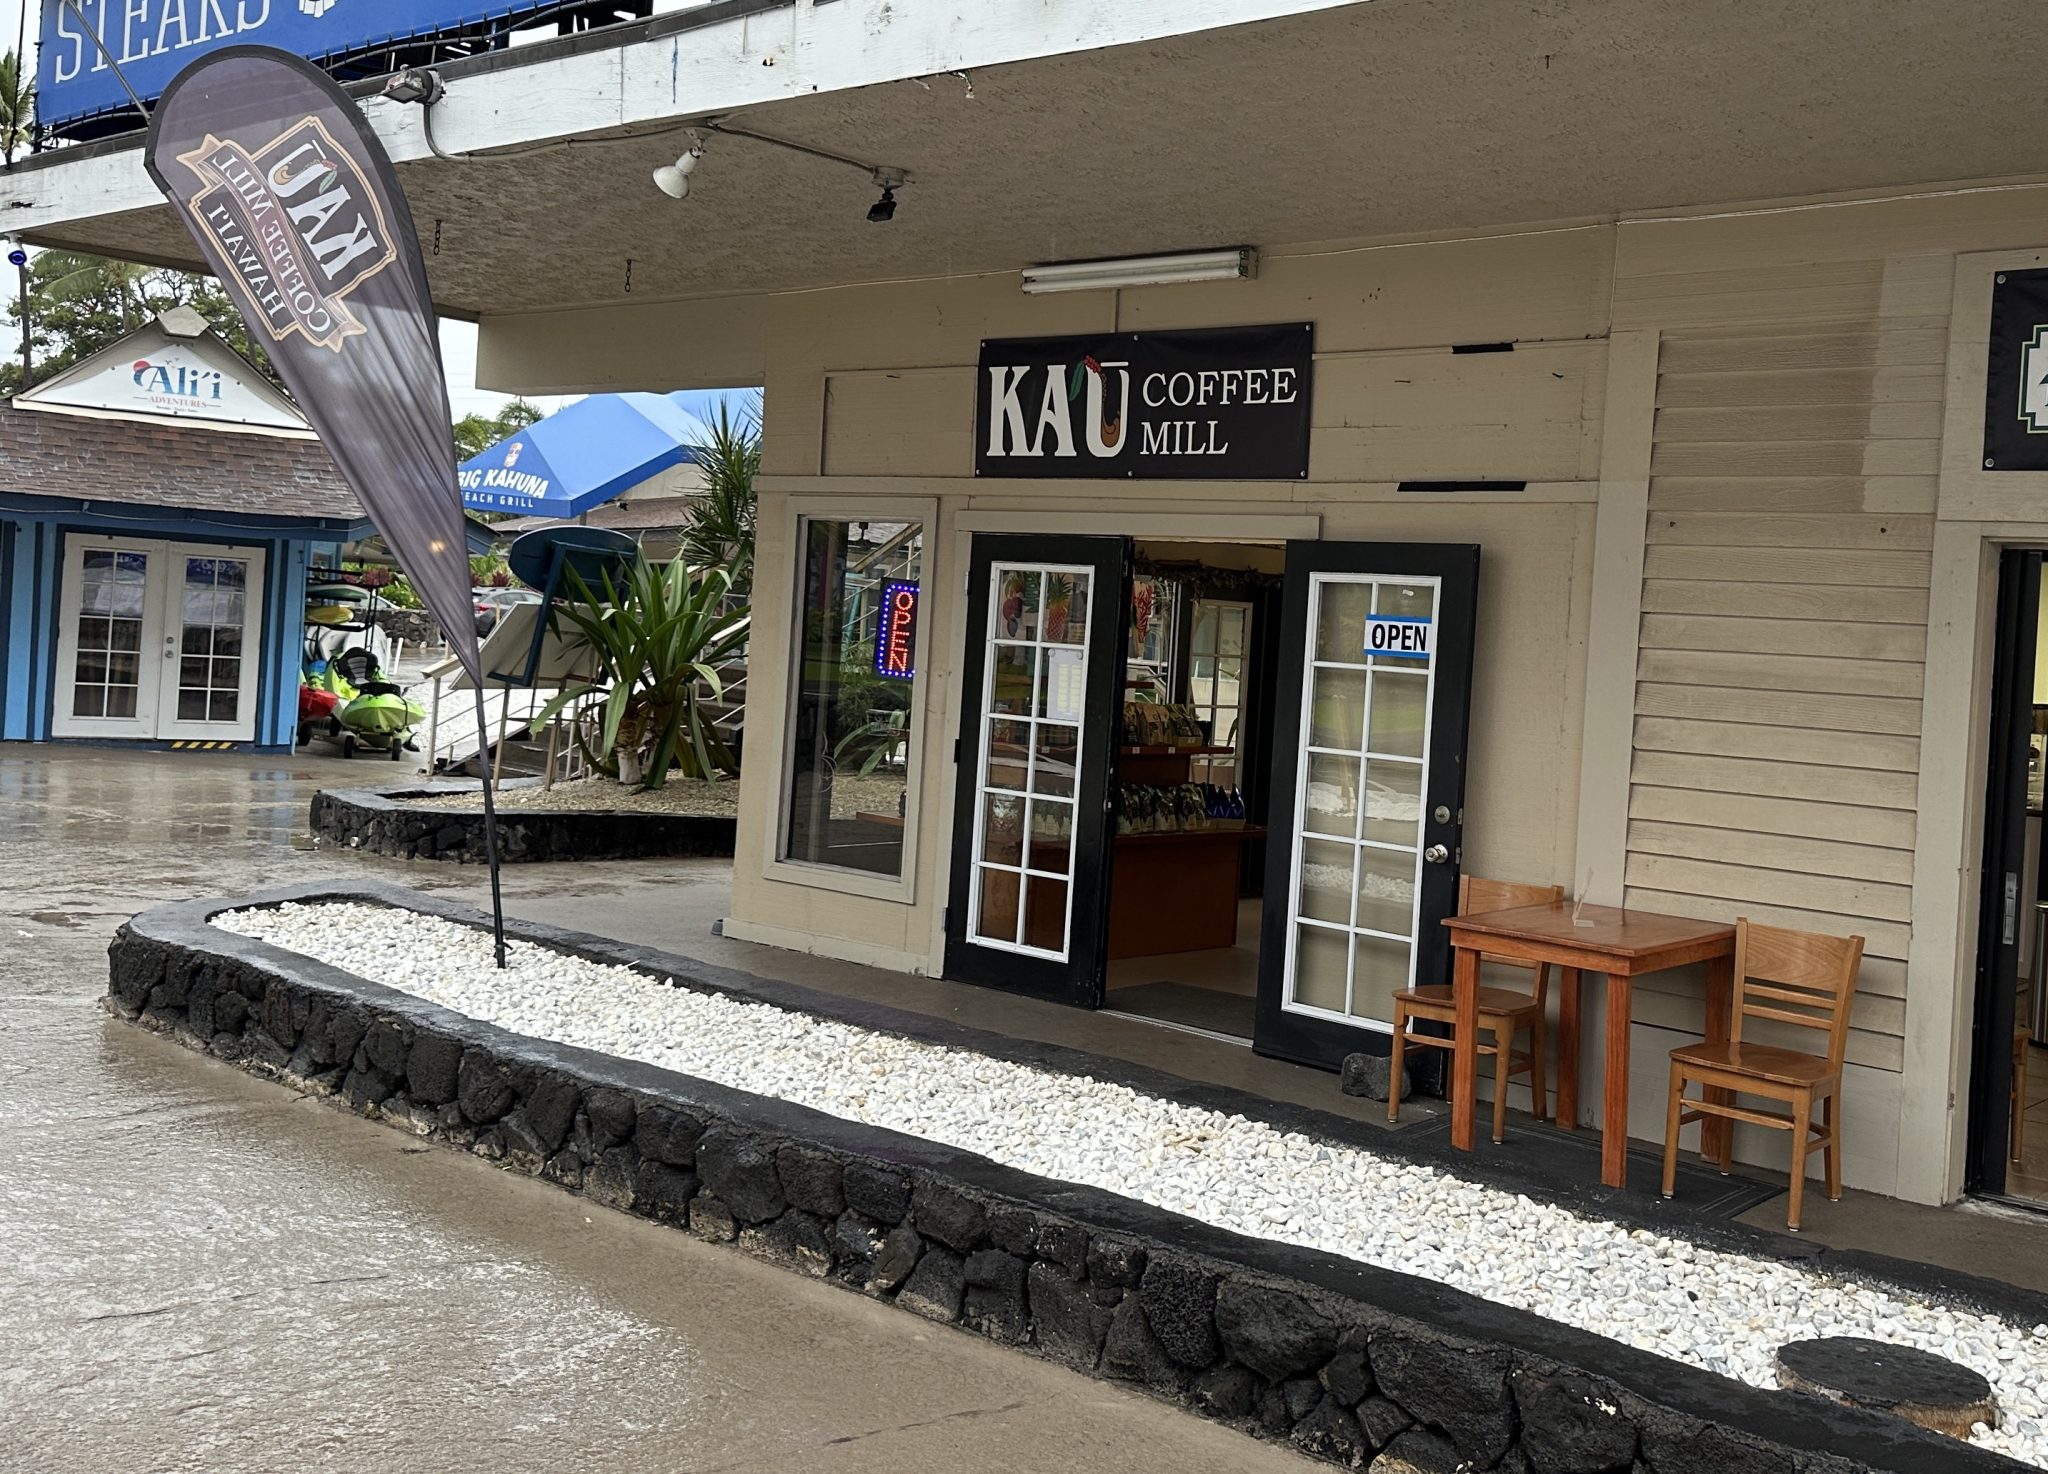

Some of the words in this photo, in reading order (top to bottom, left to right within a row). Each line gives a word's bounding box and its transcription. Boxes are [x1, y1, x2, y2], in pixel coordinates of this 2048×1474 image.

[149, 396, 208, 409] ADVENTURES
[1142, 367, 1298, 407] COFFEE
[1140, 420, 1229, 456] MILL
[482, 468, 549, 499] KAHUNA
[461, 491, 494, 504] EACH
[499, 495, 534, 508] GRILL
[887, 591, 914, 672] OPEN
[1371, 623, 1427, 652] OPEN
